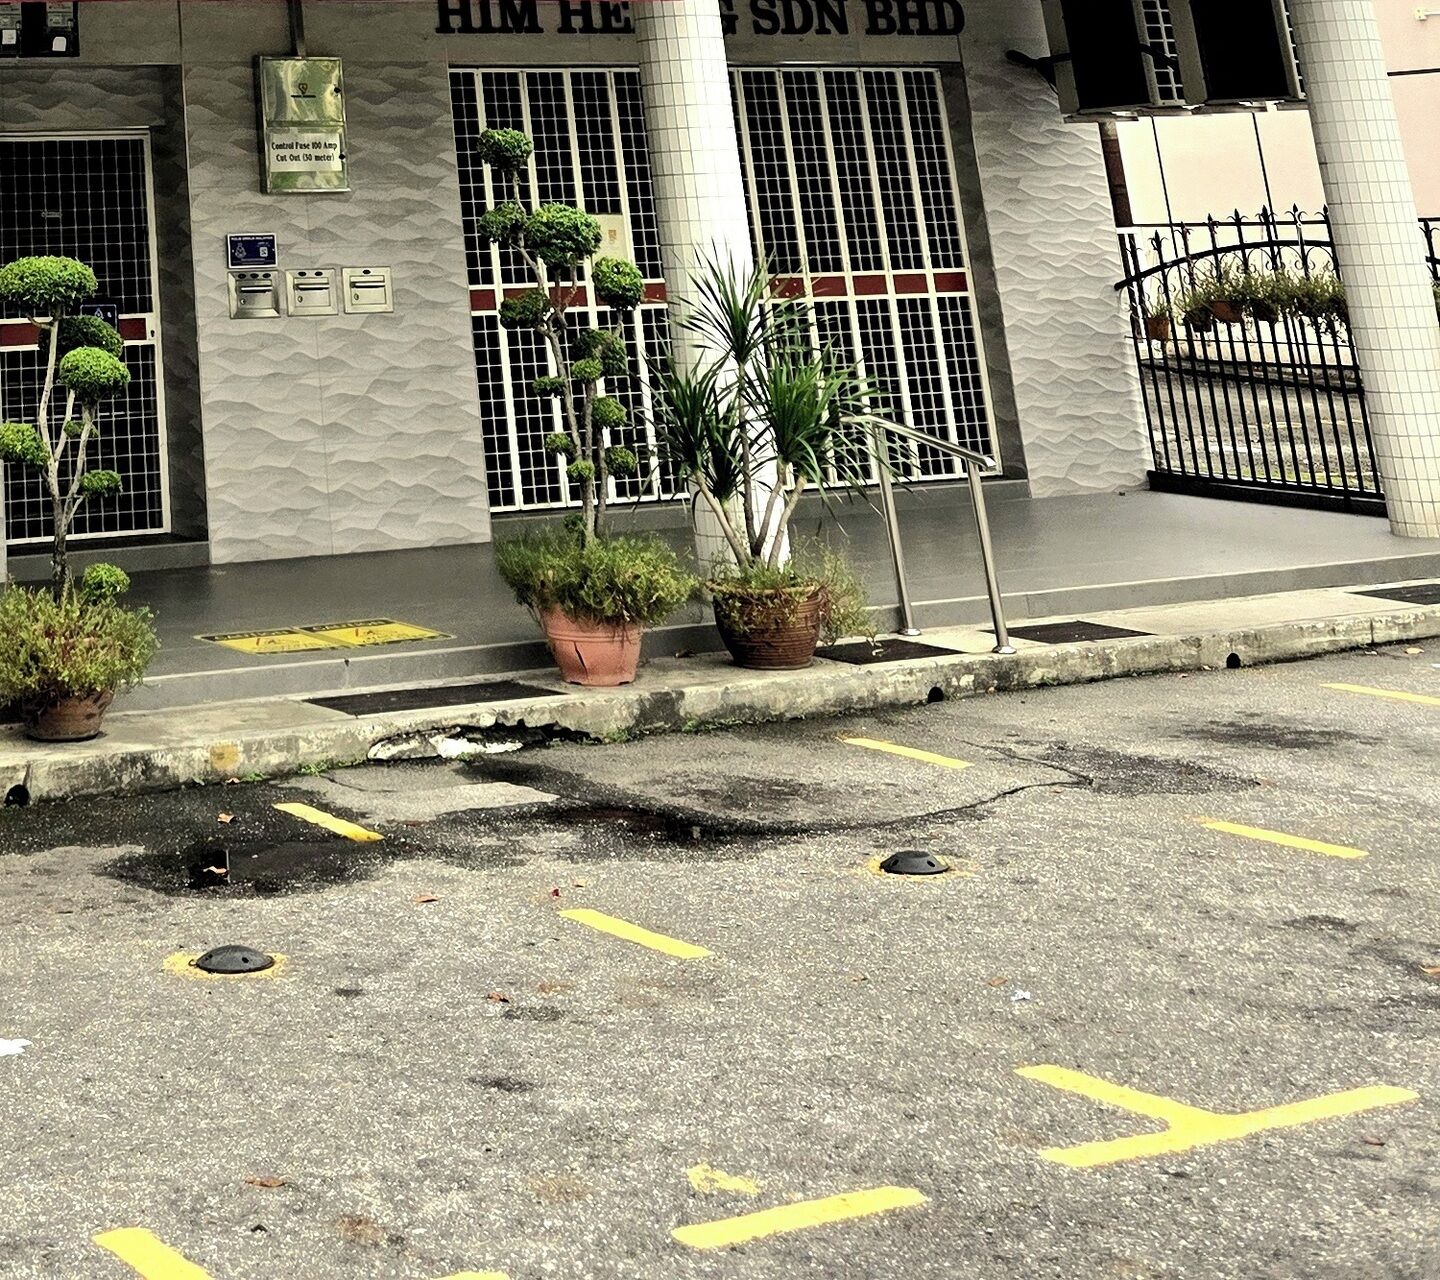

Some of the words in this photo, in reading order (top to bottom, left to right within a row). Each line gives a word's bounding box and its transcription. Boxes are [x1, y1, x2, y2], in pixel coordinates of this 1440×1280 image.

[271, 141, 294, 150] Control
[295, 141, 311, 150] Fuse
[323, 141, 337, 151] Amp
[275, 153, 287, 162] Cut
[289, 153, 301, 162] Out
[314, 153, 335, 162] meter)
